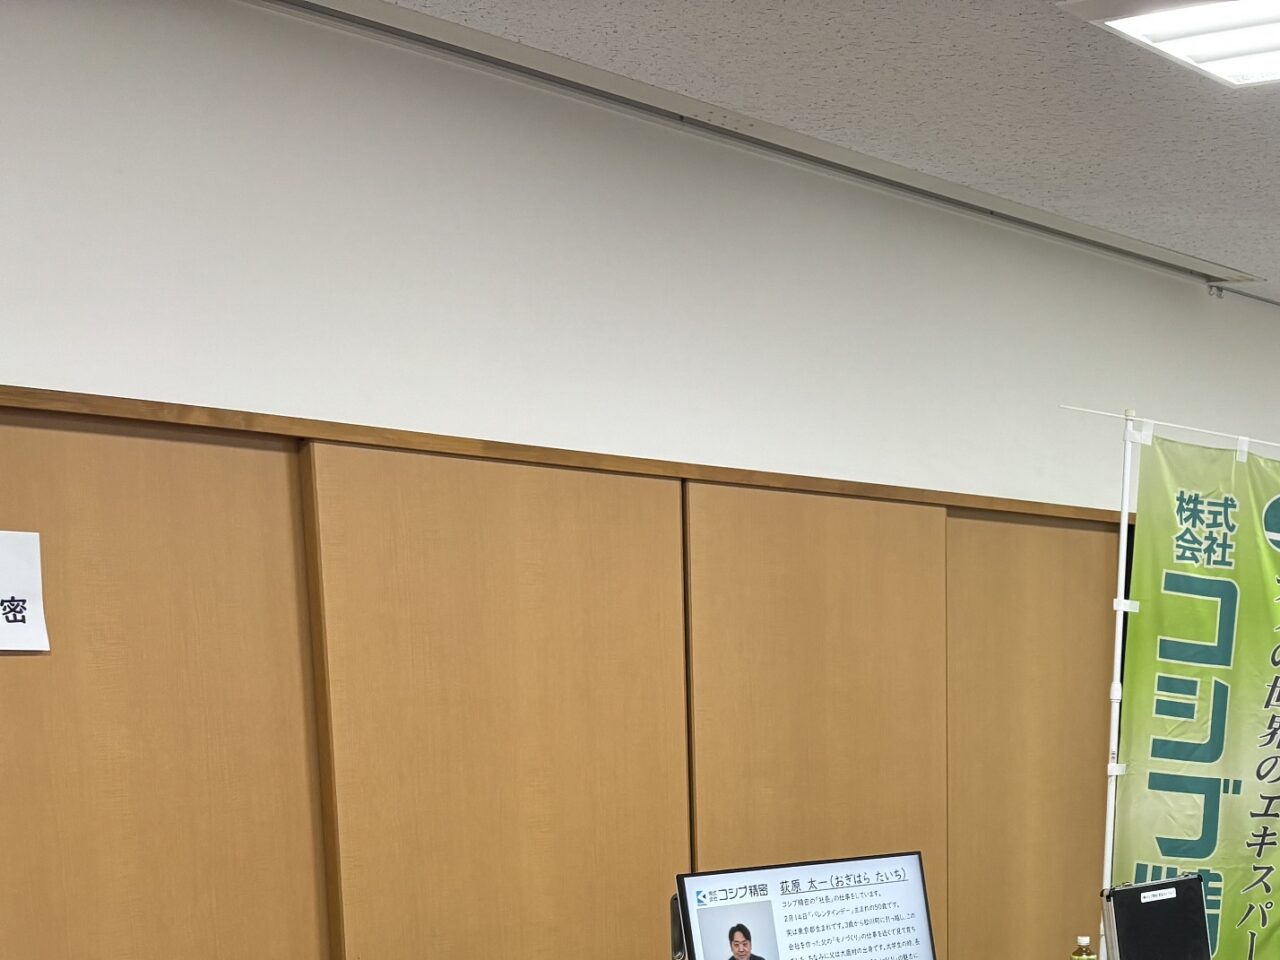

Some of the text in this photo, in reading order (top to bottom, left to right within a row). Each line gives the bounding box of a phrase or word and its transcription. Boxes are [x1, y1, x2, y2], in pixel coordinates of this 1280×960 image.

[1176, 490, 1237, 533] 株式
[1175, 527, 1233, 567] 会社
[0, 596, 28, 624] 密
[718, 884, 769, 901] コシブ精密
[780, 880, 801, 894] 荻原
